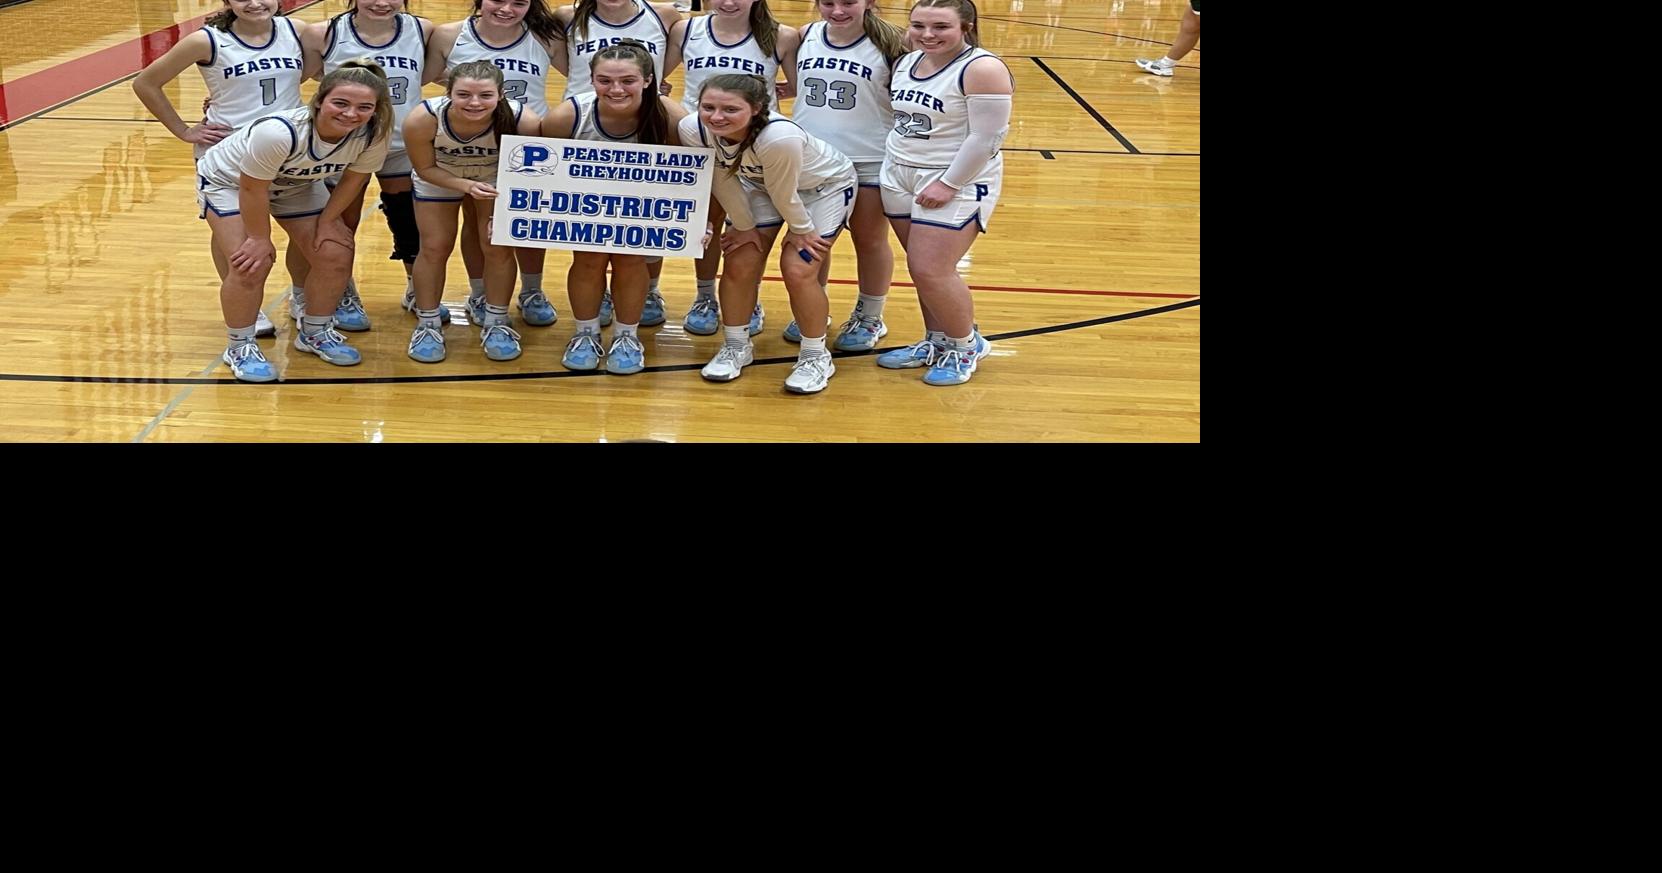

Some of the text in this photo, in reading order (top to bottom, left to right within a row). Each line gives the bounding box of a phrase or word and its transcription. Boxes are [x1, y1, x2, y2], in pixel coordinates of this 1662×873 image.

[576, 37, 658, 56] PEASR
[224, 57, 303, 79] PEASTER
[374, 55, 419, 73] STER
[494, 58, 541, 76] STER
[687, 56, 765, 76] PEASTER
[798, 57, 873, 82] PEASTER
[259, 77, 277, 106] 1
[387, 76, 409, 106] 3
[503, 79, 528, 105] 2
[804, 77, 857, 110] 33
[891, 89, 946, 114] EASTER
[894, 109, 933, 140] 22
[438, 145, 497, 157] EASTE
[523, 145, 549, 168] P
[562, 146, 651, 166] PEASTER
[655, 152, 708, 169] LADY
[279, 162, 352, 177] EASTE
[568, 163, 698, 186] GREYHOUNDS
[844, 186, 854, 207] P
[975, 184, 989, 202] P
[509, 188, 696, 222] BI-DISTRICT
[510, 217, 688, 251] CHAMPIONS
